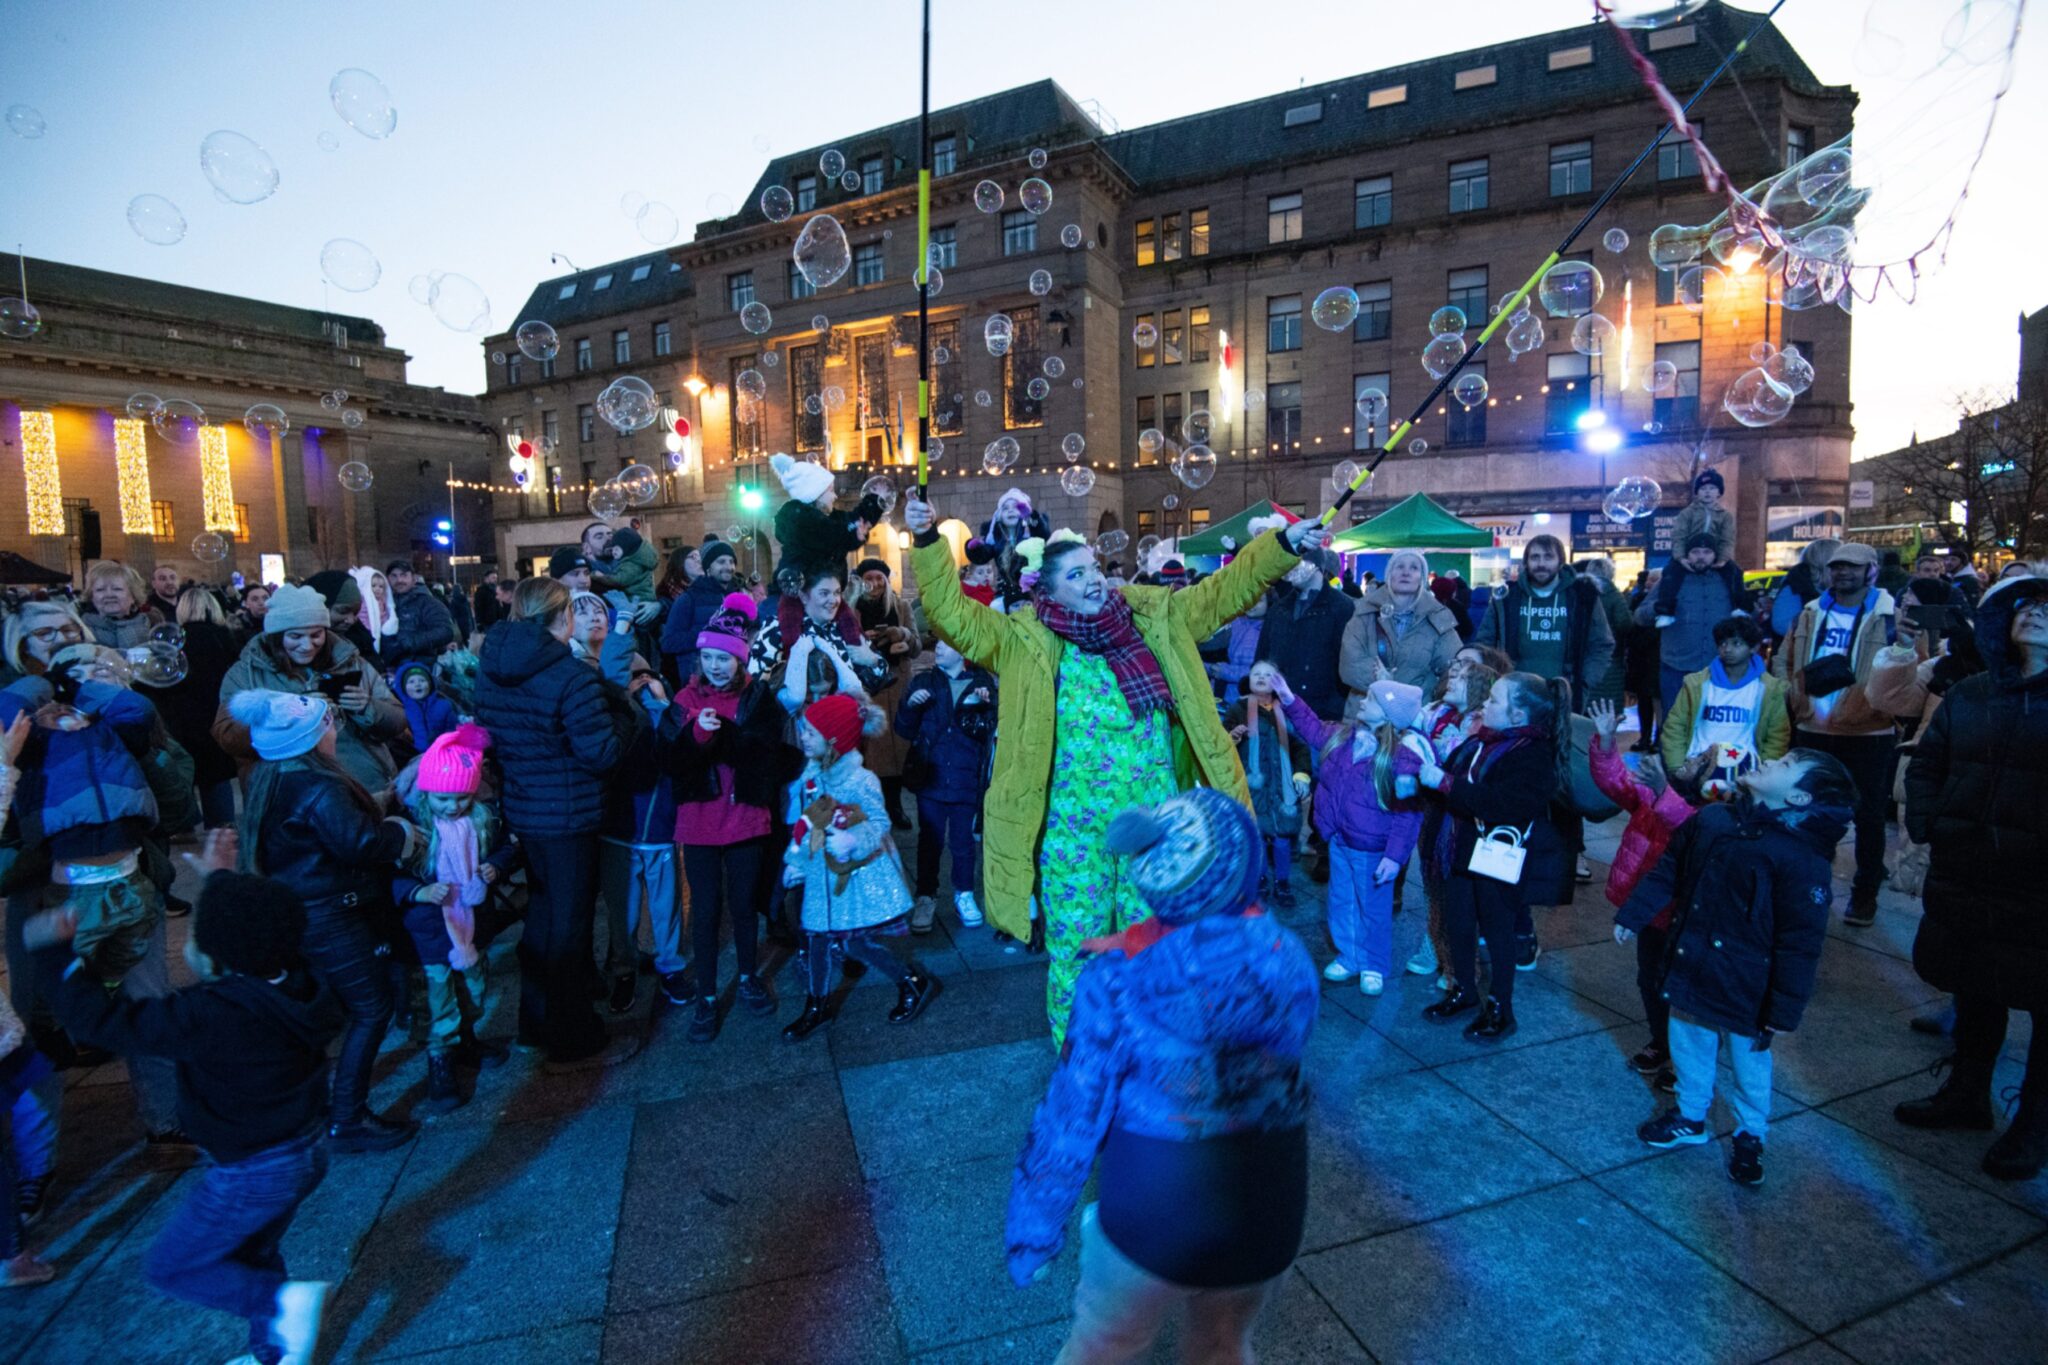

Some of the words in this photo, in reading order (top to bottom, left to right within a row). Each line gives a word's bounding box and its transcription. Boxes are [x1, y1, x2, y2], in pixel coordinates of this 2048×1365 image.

[1653, 516, 1674, 527] DUN
[1653, 540, 1673, 551] CEN
[1520, 606, 1567, 618] SUPERDR
